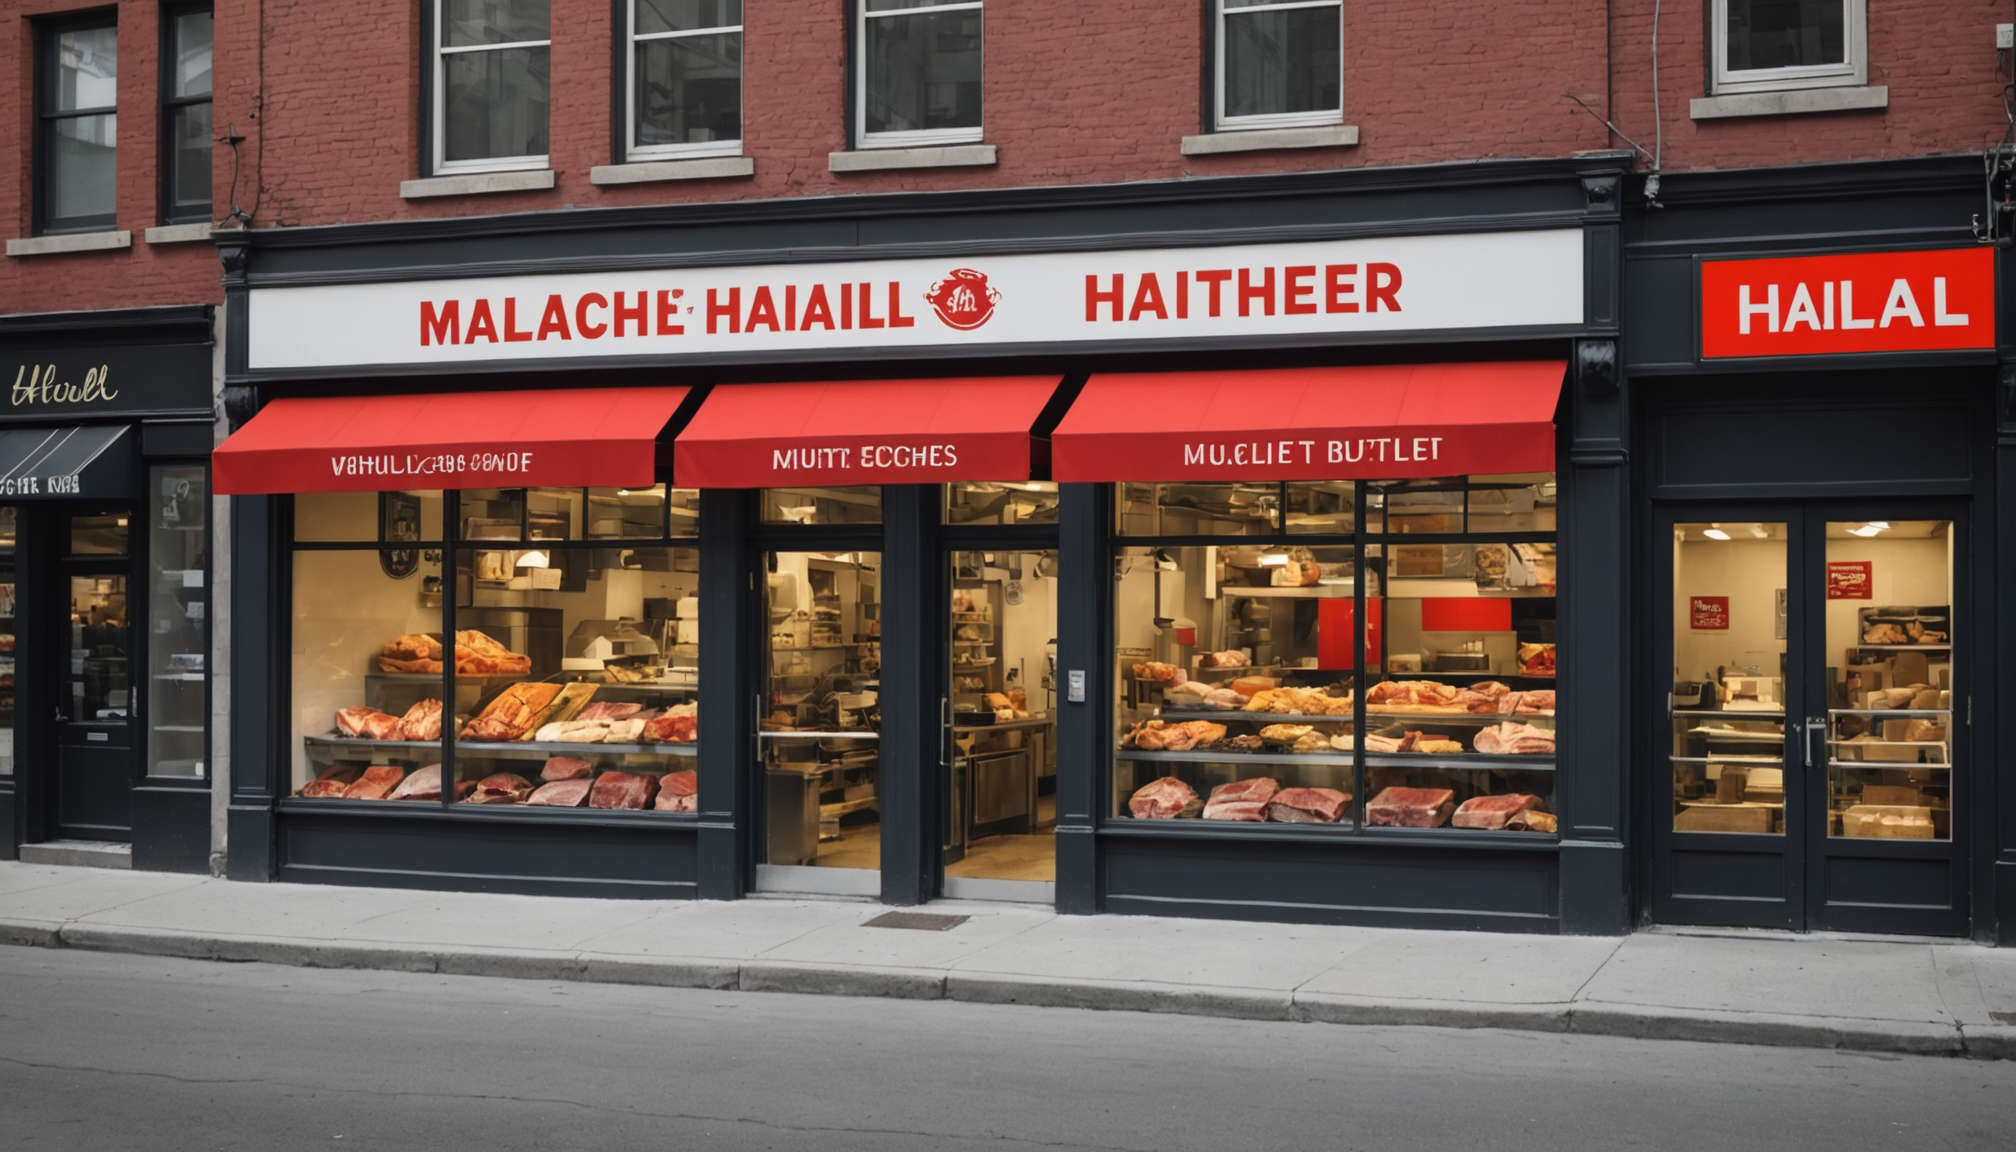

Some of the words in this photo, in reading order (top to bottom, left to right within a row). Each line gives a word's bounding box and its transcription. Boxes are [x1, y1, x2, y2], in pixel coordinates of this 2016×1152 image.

[706, 281, 915, 334] HAIAILL
[1085, 262, 1403, 322] HAITHEER
[1738, 276, 1970, 335] HAILAL
